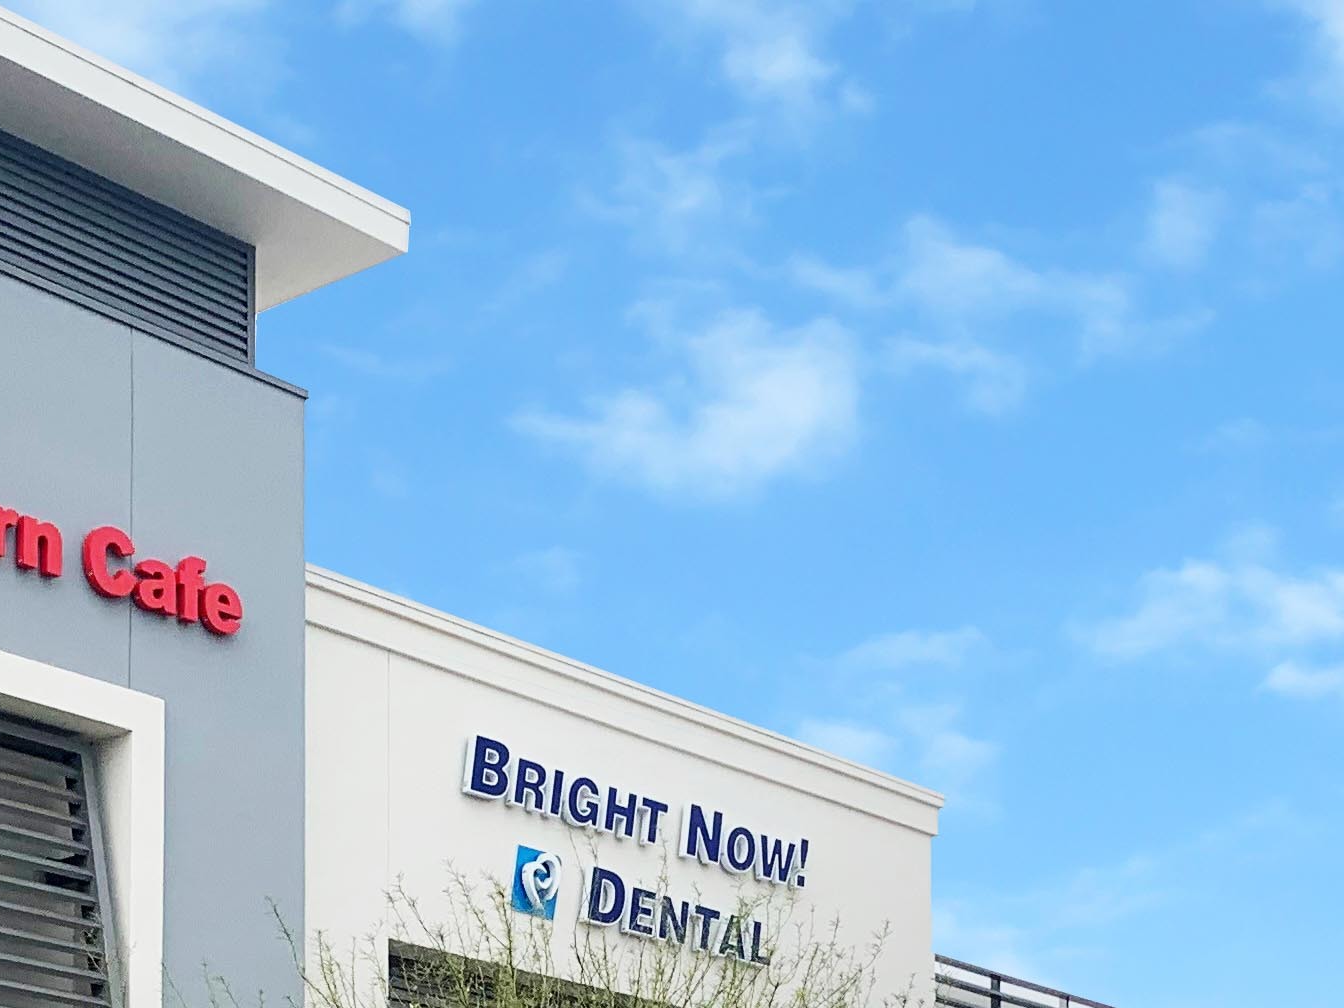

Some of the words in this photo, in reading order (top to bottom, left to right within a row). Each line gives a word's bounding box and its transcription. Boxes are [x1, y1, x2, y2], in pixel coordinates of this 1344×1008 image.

[82, 525, 243, 636] Cafe
[464, 735, 668, 846] BRIGHT
[679, 803, 810, 889] NOW!
[581, 866, 771, 967] DENTAL
